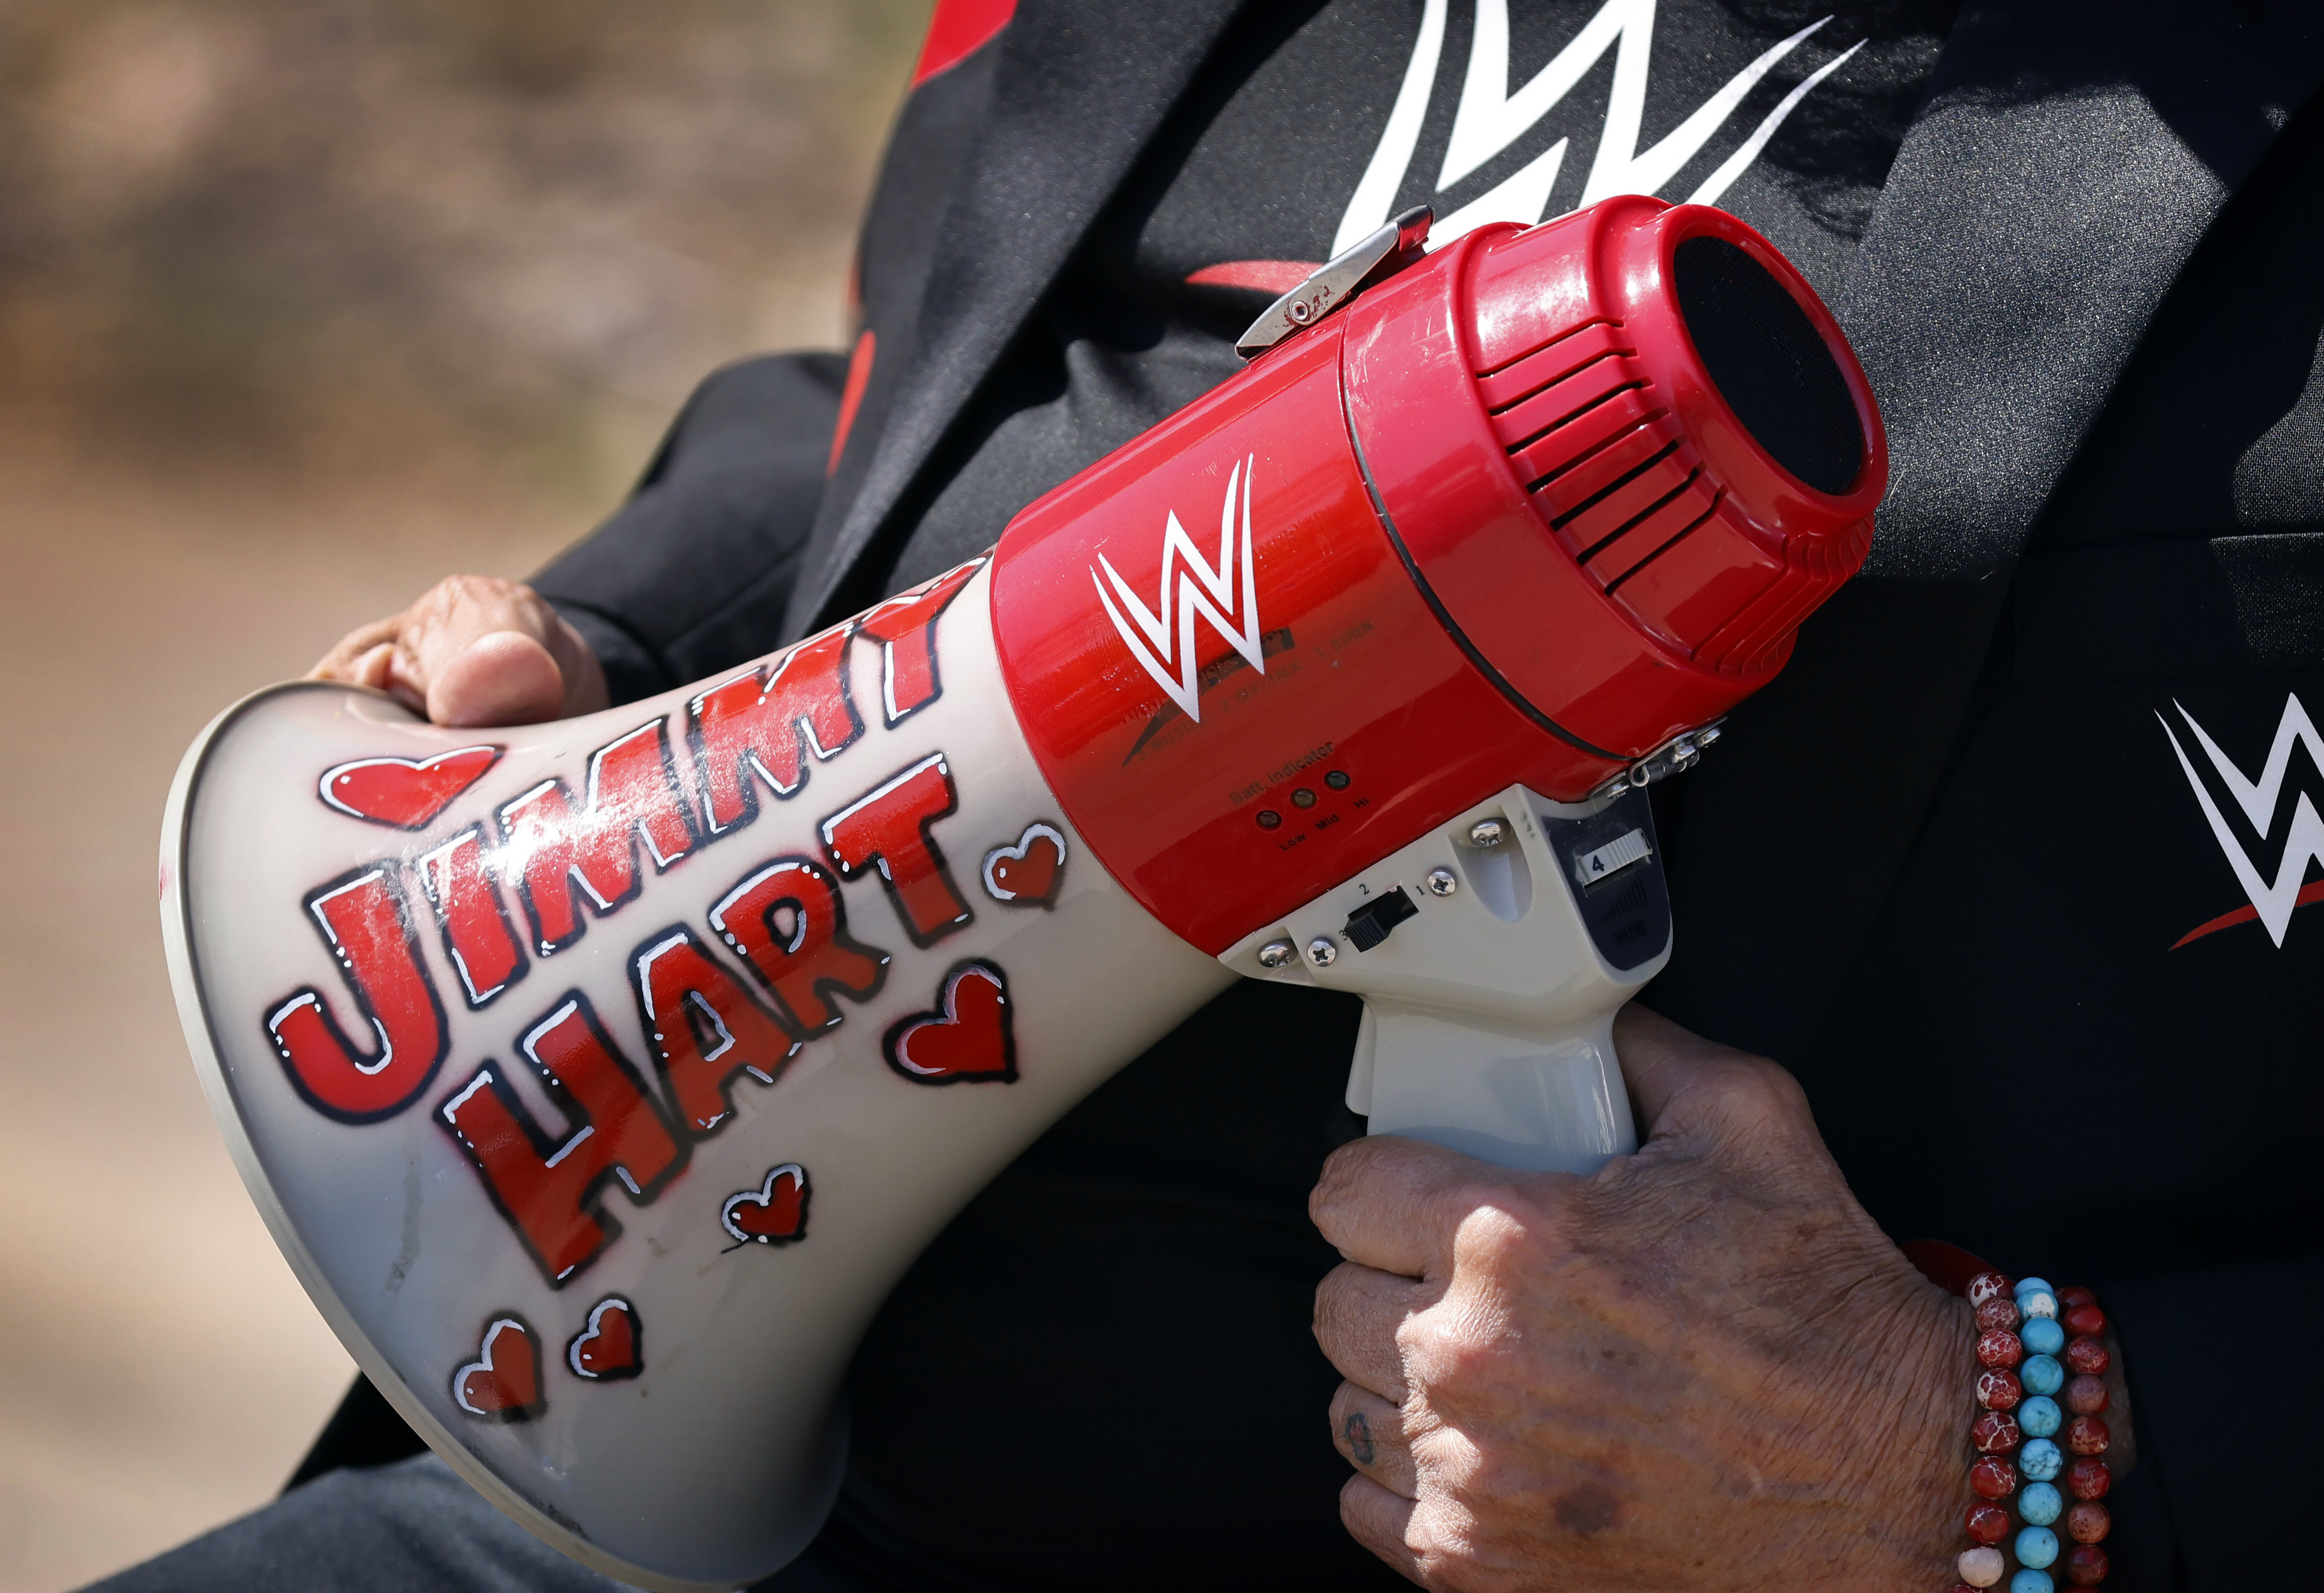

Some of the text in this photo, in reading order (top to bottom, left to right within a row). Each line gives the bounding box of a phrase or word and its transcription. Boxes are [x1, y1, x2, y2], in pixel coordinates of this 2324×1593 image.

[1331, 621, 1374, 650] SIREN
[1266, 741, 1334, 784] Indicator
[262, 549, 994, 1124] JIMMY
[1279, 834, 1306, 850] Low
[1592, 855, 1605, 871] 4
[1359, 883, 1370, 895] 2
[1416, 885, 1425, 896] 1
[1338, 930, 1348, 941] 3
[436, 750, 974, 1288] HART
